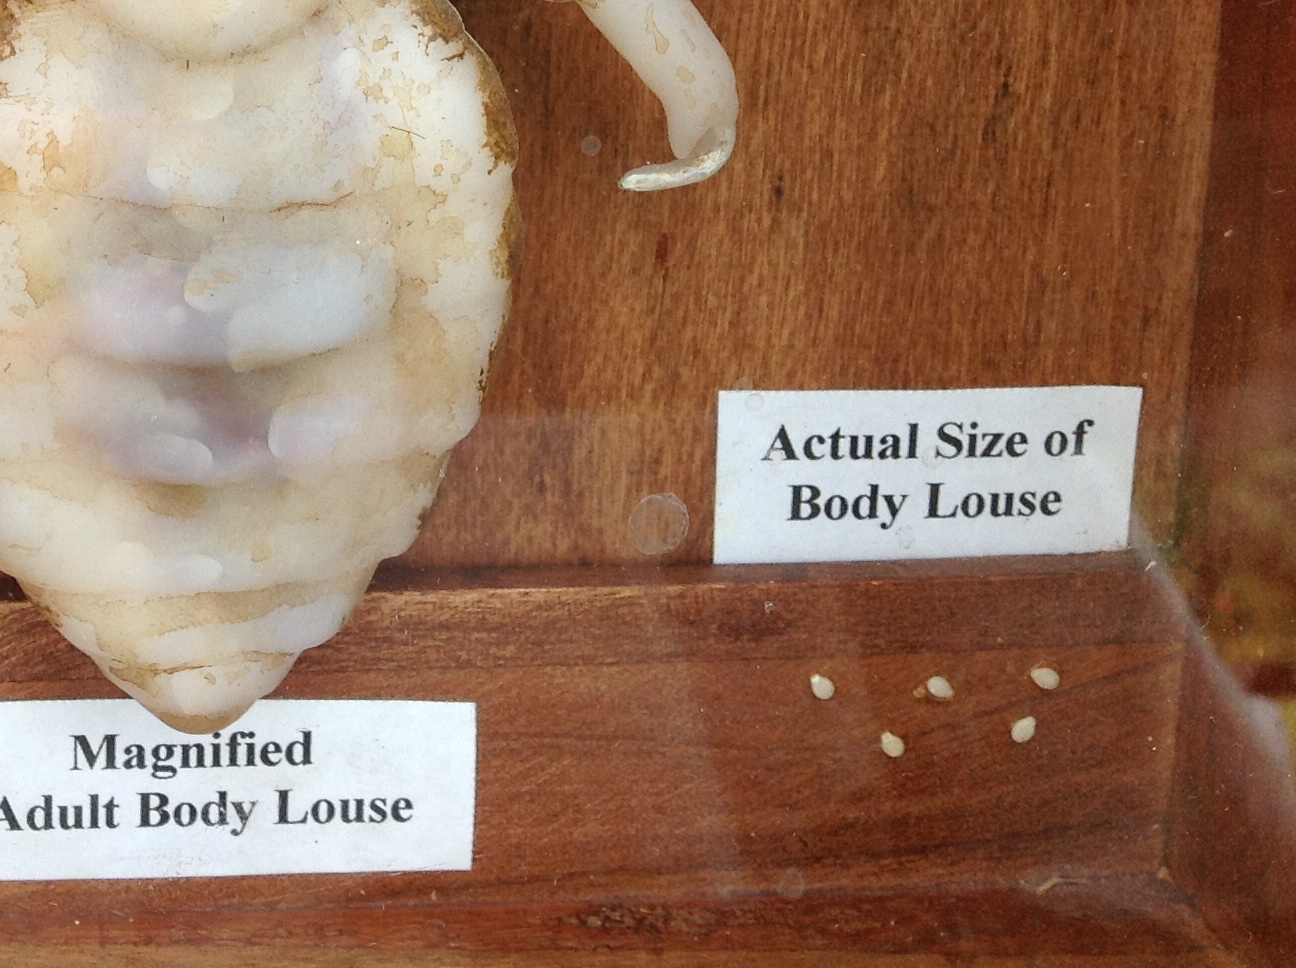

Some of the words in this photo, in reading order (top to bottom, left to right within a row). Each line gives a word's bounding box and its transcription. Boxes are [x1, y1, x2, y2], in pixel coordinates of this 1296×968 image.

[761, 423, 919, 461] Actual
[934, 421, 1028, 459] Size
[1044, 419, 1095, 457] of
[787, 483, 909, 529] Body
[924, 482, 1062, 519] Louse
[70, 730, 313, 779] Magnified
[136, 790, 257, 836] Body
[273, 789, 414, 827] Louse
